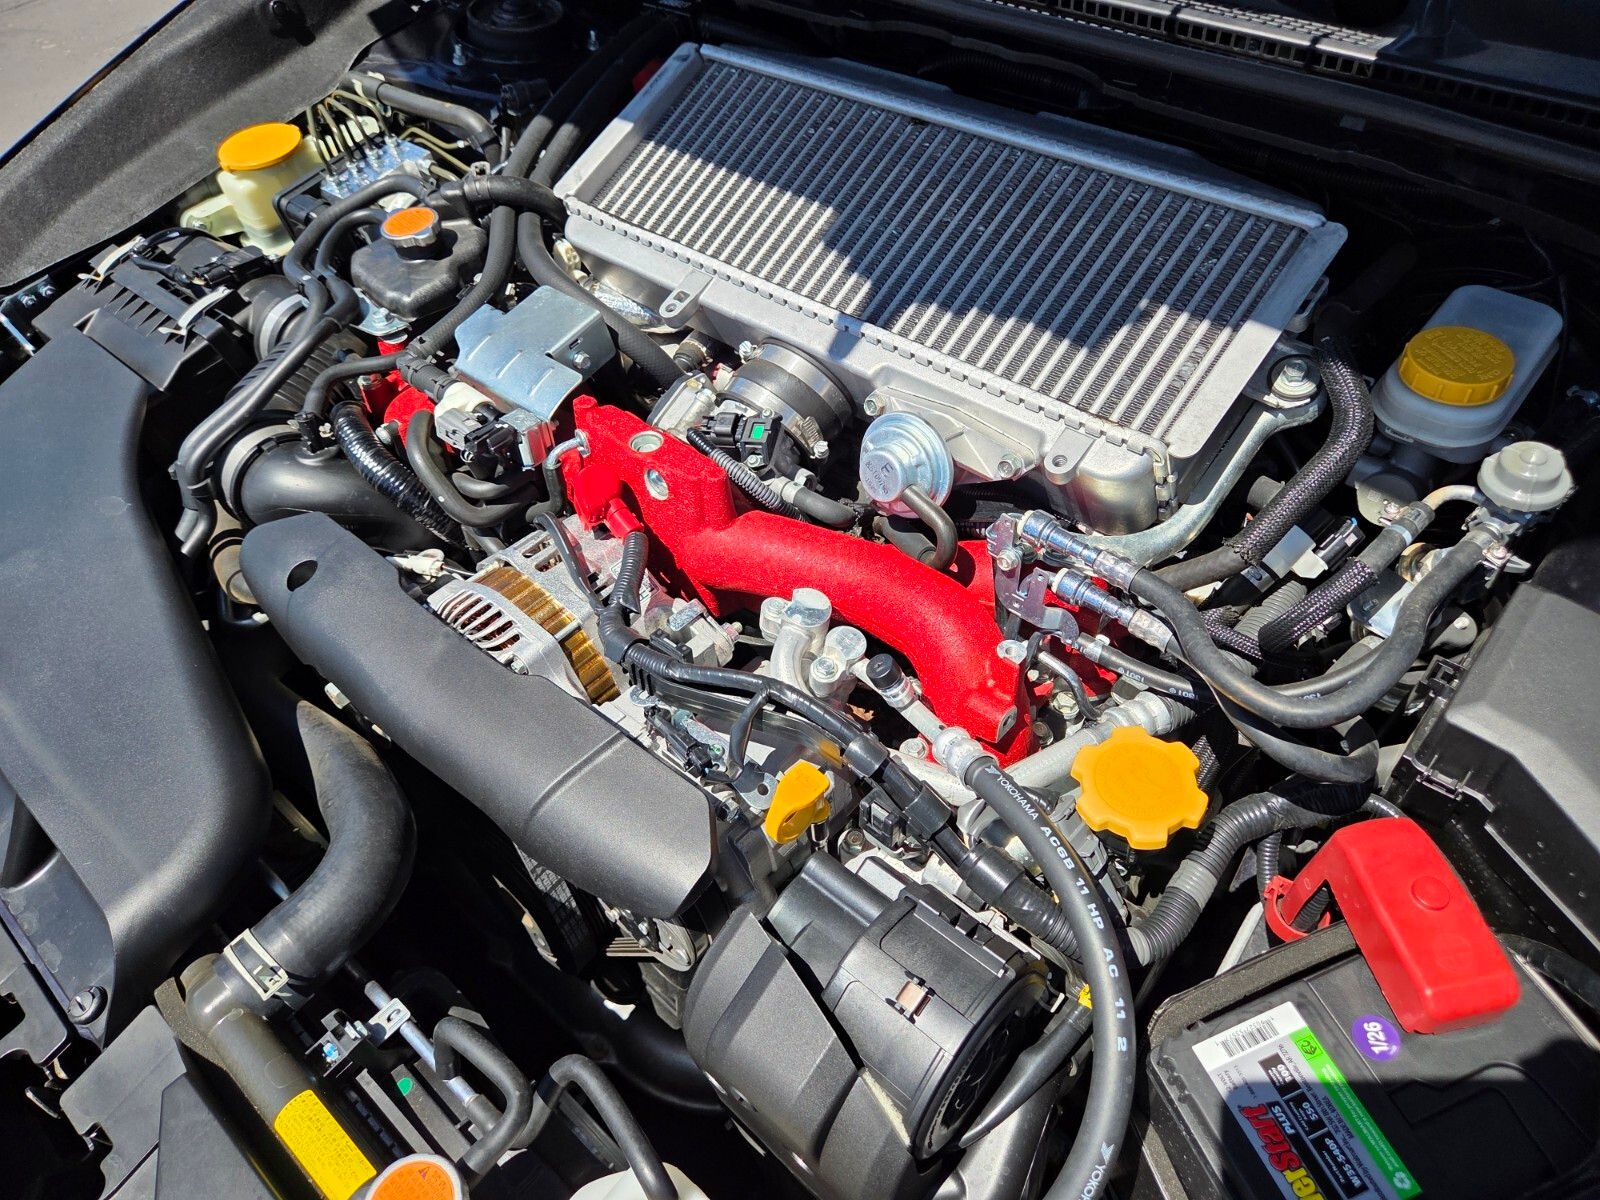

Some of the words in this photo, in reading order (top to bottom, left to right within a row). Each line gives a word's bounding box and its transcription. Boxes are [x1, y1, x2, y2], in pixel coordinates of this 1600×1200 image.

[880, 462, 894, 477] E
[996, 775, 1039, 820] YOKOHAMA
[1040, 826, 1075, 870] AC6B
[1075, 878, 1090, 895] 11
[1086, 902, 1105, 930] HP
[1102, 947, 1119, 978] AC
[1114, 996, 1126, 1019] 11
[1116, 1035, 1128, 1051] 2
[1364, 1021, 1389, 1055] 1/26
[1277, 1062, 1293, 1082] 100
[1271, 1105, 1295, 1135] PLUS
[1302, 1101, 1319, 1121] 550
[1239, 1102, 1324, 1200] erStart
[1323, 1136, 1363, 1188] W35-540P
[1076, 1161, 1107, 1200] YOKO
